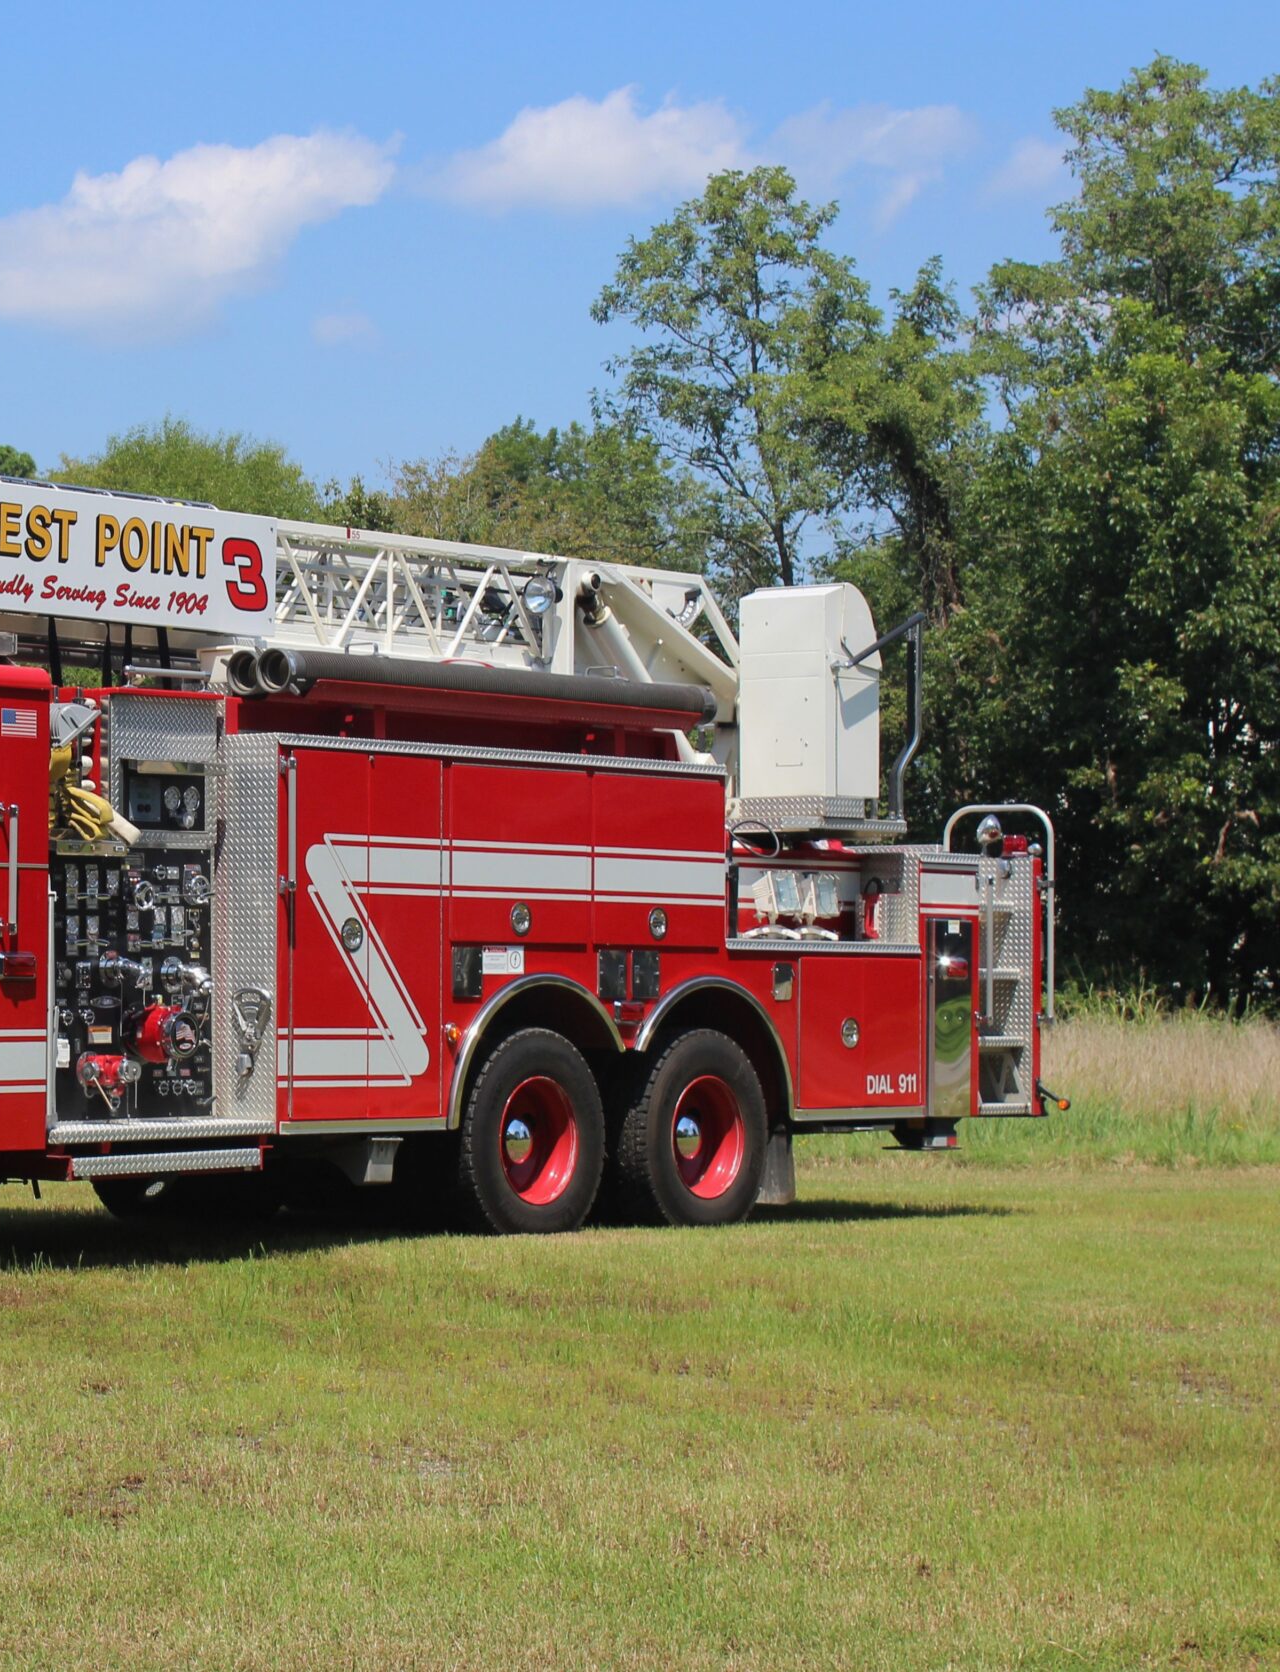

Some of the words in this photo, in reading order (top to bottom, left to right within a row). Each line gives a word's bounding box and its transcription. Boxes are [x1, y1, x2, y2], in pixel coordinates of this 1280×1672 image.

[95, 513, 214, 579] POINT
[222, 537, 268, 612] 3
[40, 575, 107, 611] Serving
[113, 583, 160, 611] Since
[167, 591, 209, 615] 1904
[867, 1074, 894, 1094] DIAL
[899, 1073, 917, 1093] 911
